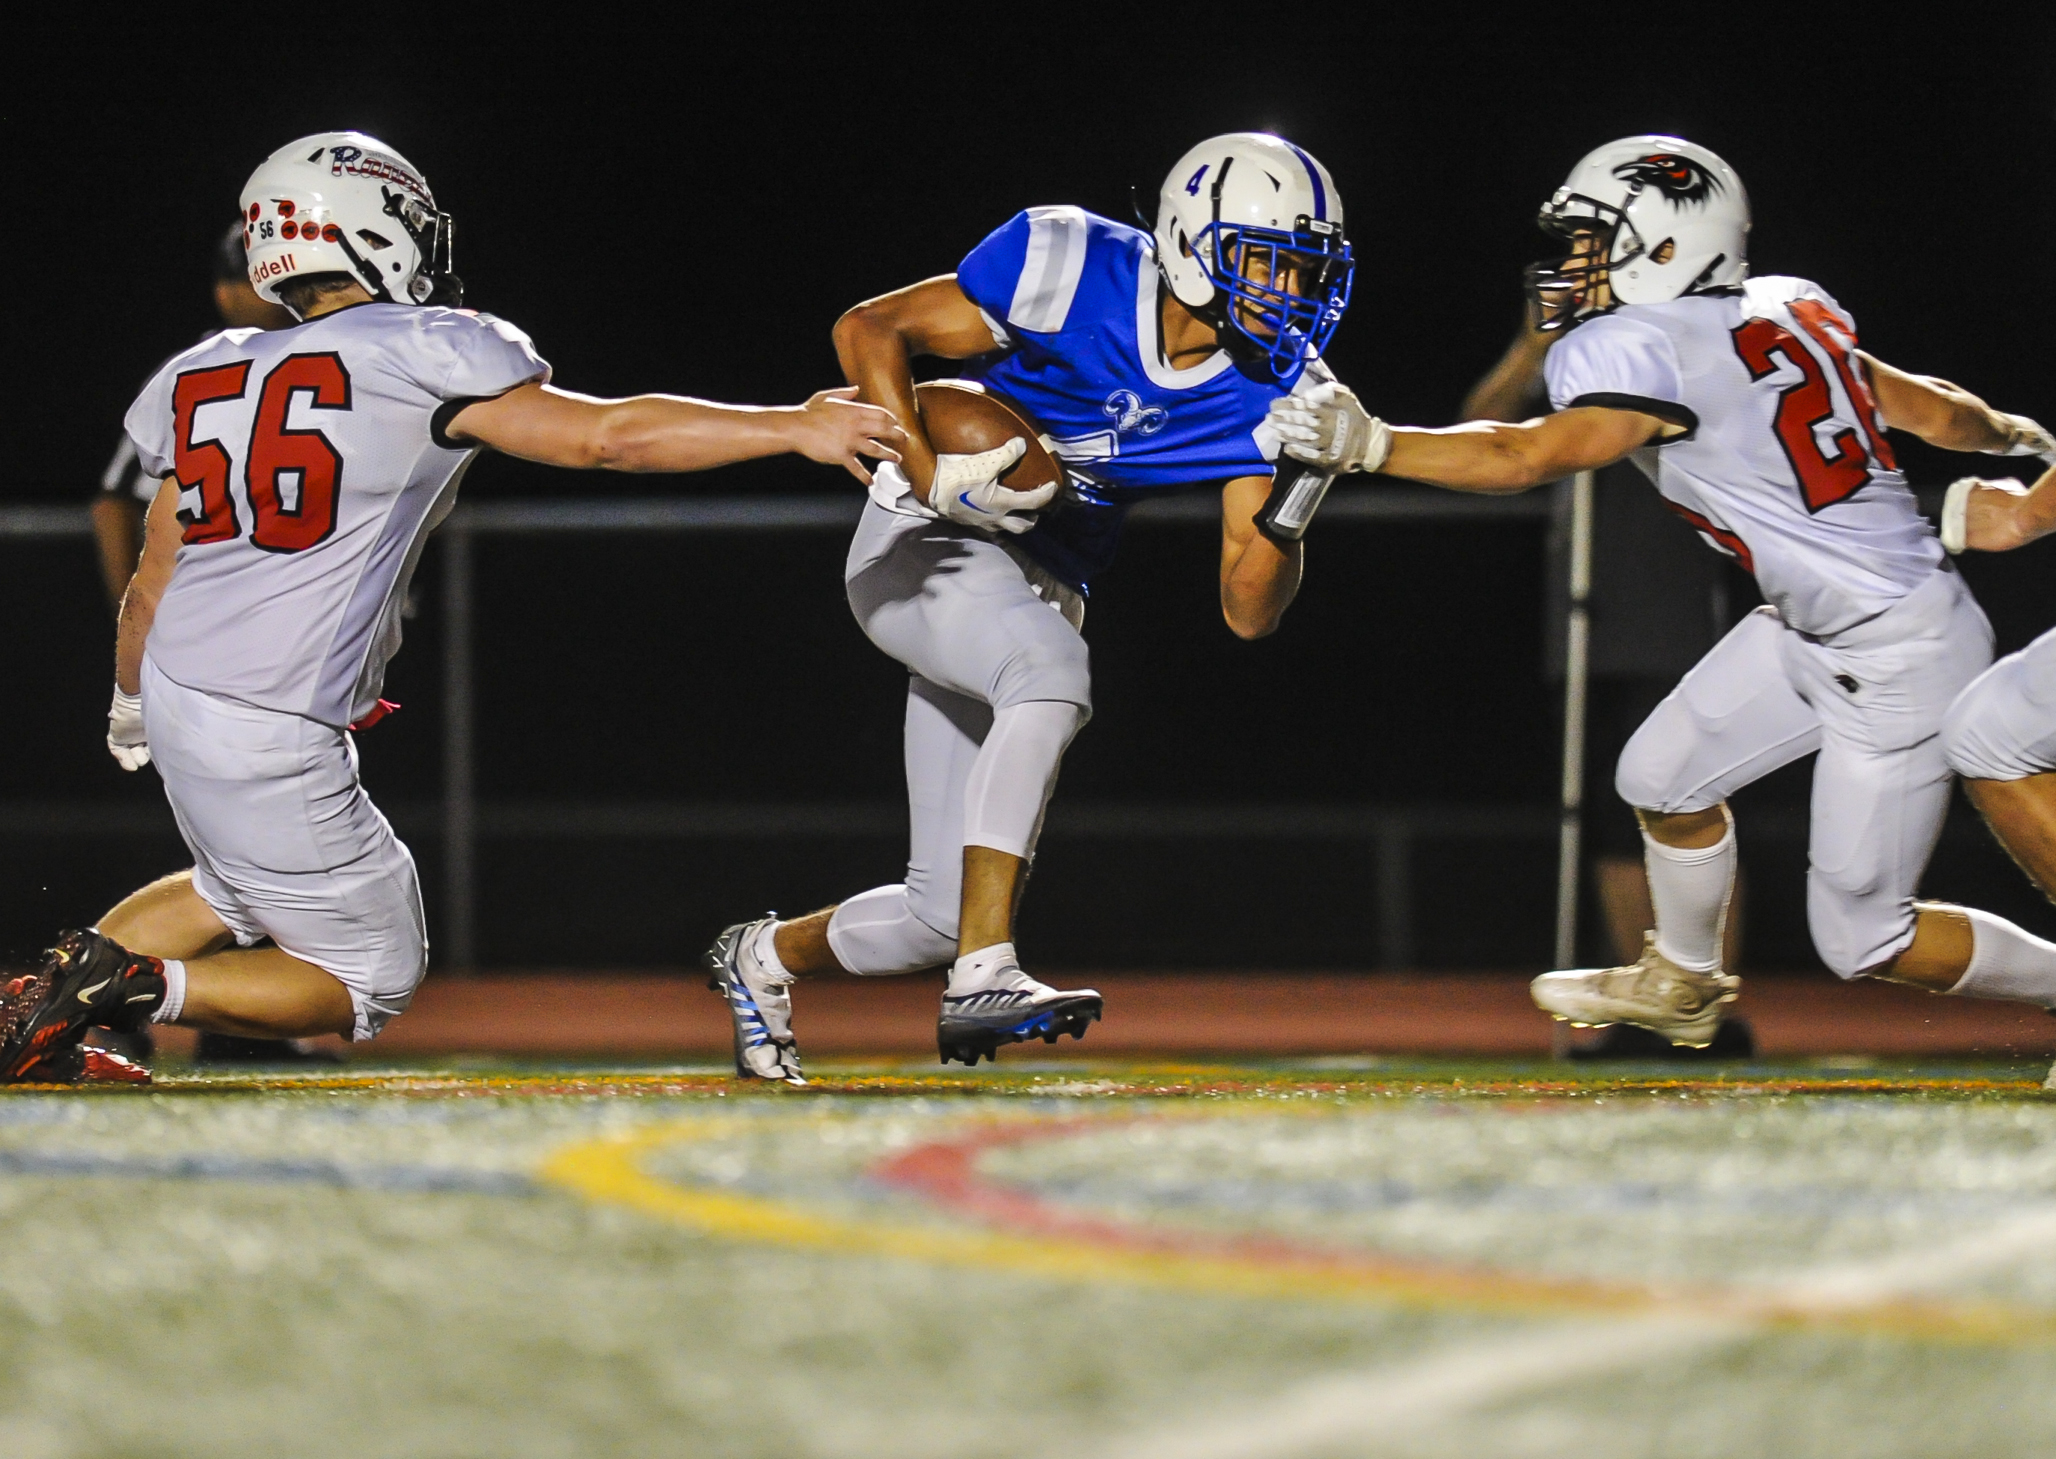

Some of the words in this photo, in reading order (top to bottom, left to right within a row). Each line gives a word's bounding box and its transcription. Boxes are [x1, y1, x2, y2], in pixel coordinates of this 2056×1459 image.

[1185, 164, 1210, 196] 4
[259, 220, 274, 240] 56
[171, 350, 353, 555] 56
